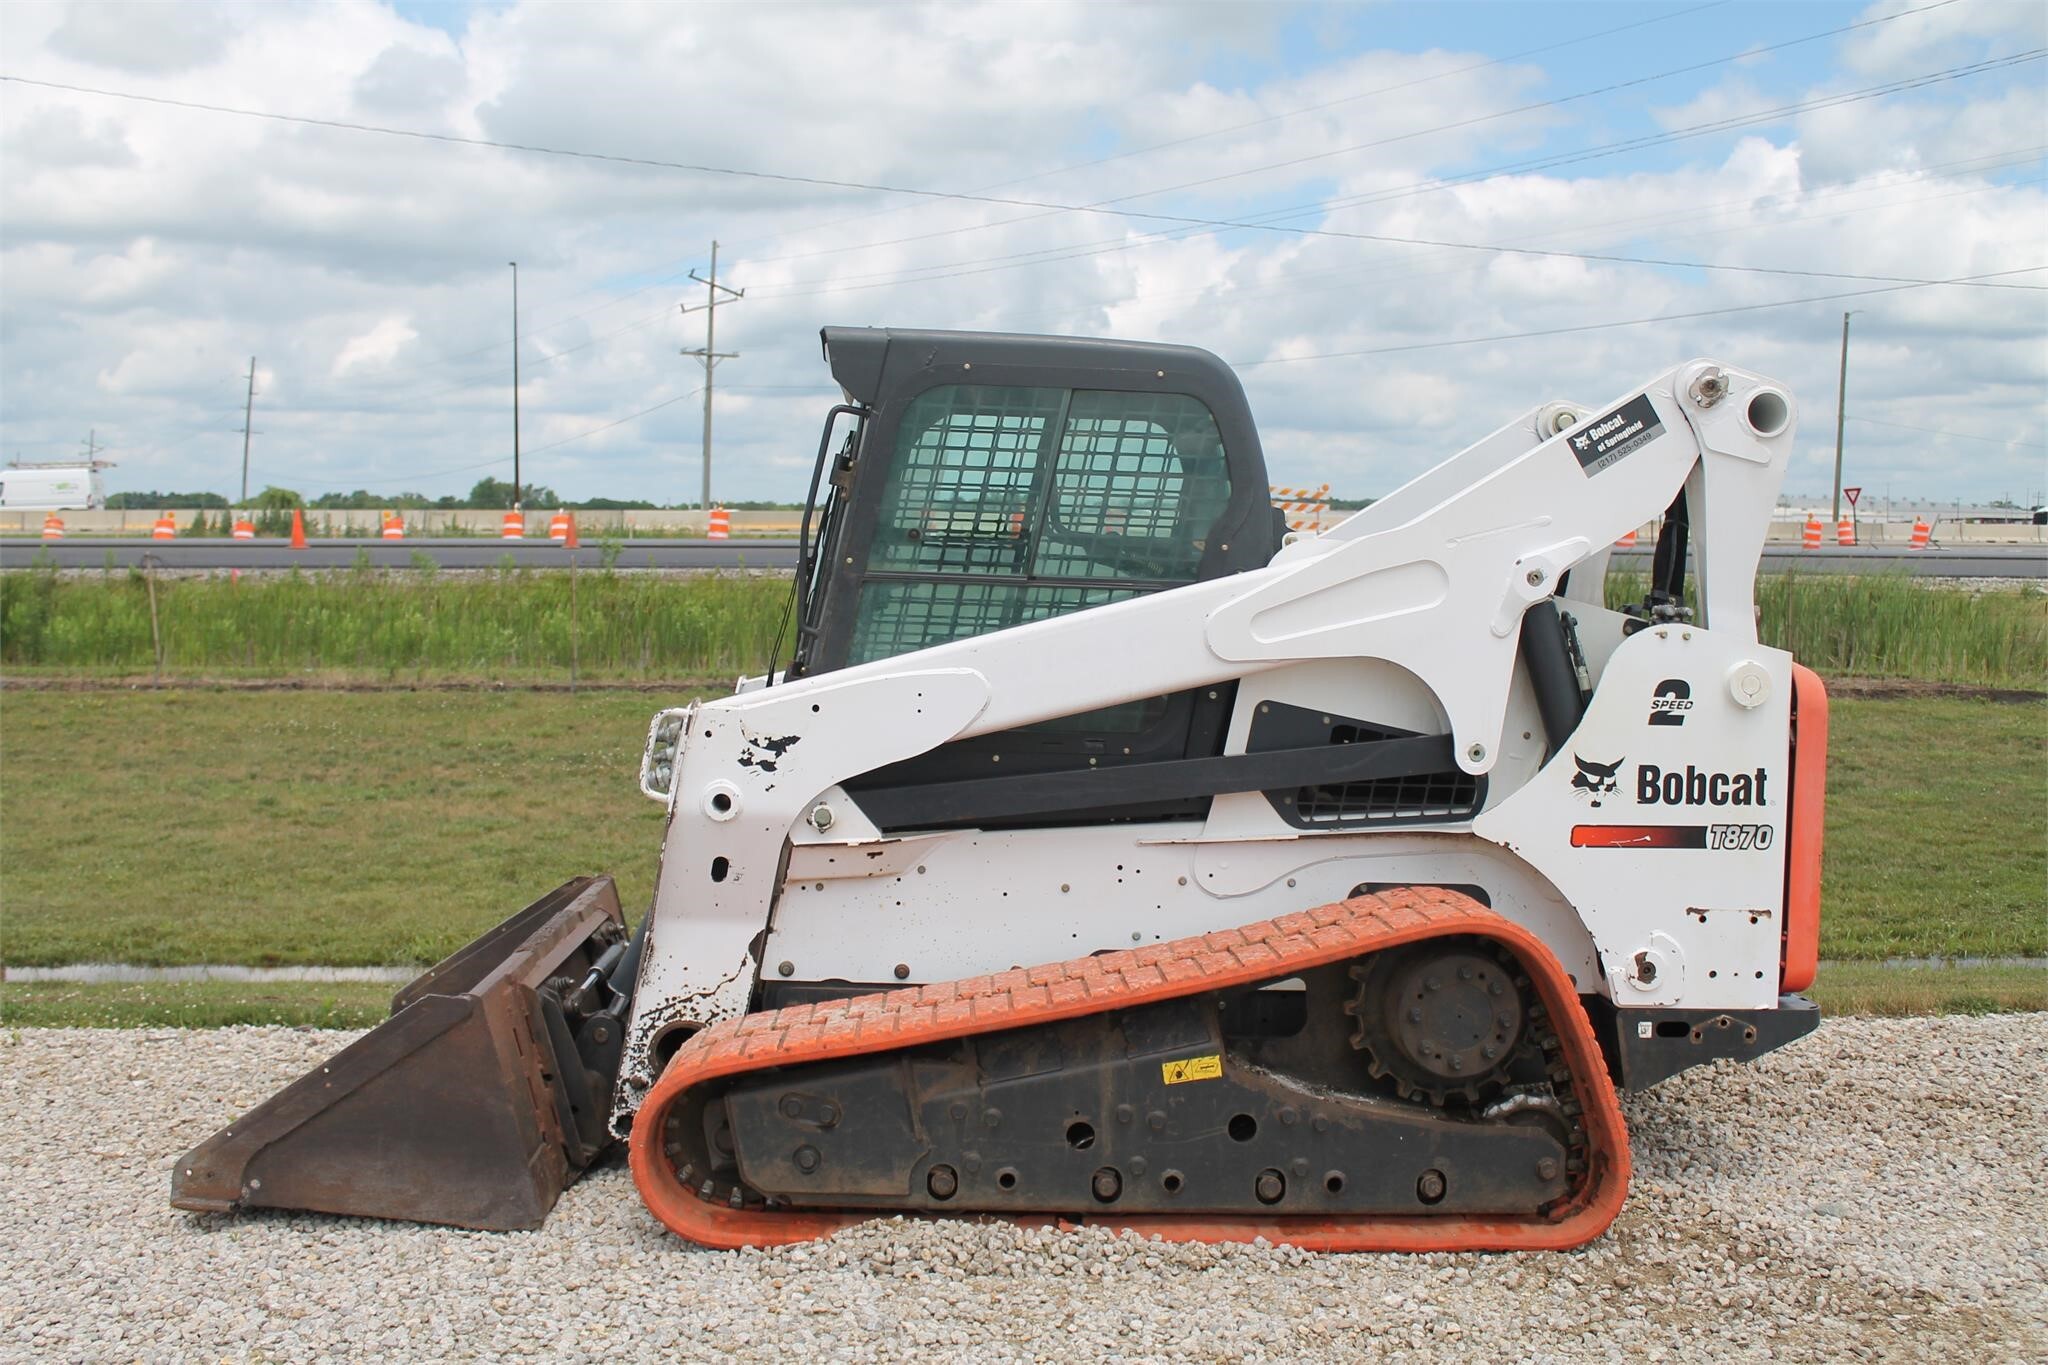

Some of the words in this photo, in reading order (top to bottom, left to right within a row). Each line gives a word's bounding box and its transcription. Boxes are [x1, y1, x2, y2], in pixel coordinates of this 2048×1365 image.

[1589, 414, 1625, 441] Bobcat
[1597, 442, 1606, 452] of
[1604, 420, 1643, 447] Springfield
[1597, 454, 1617, 469] (217)
[1648, 679, 1691, 726] 2
[1650, 699, 1694, 710] SPEED
[1637, 764, 1767, 806] Bobcat
[1710, 824, 1774, 851] T870
